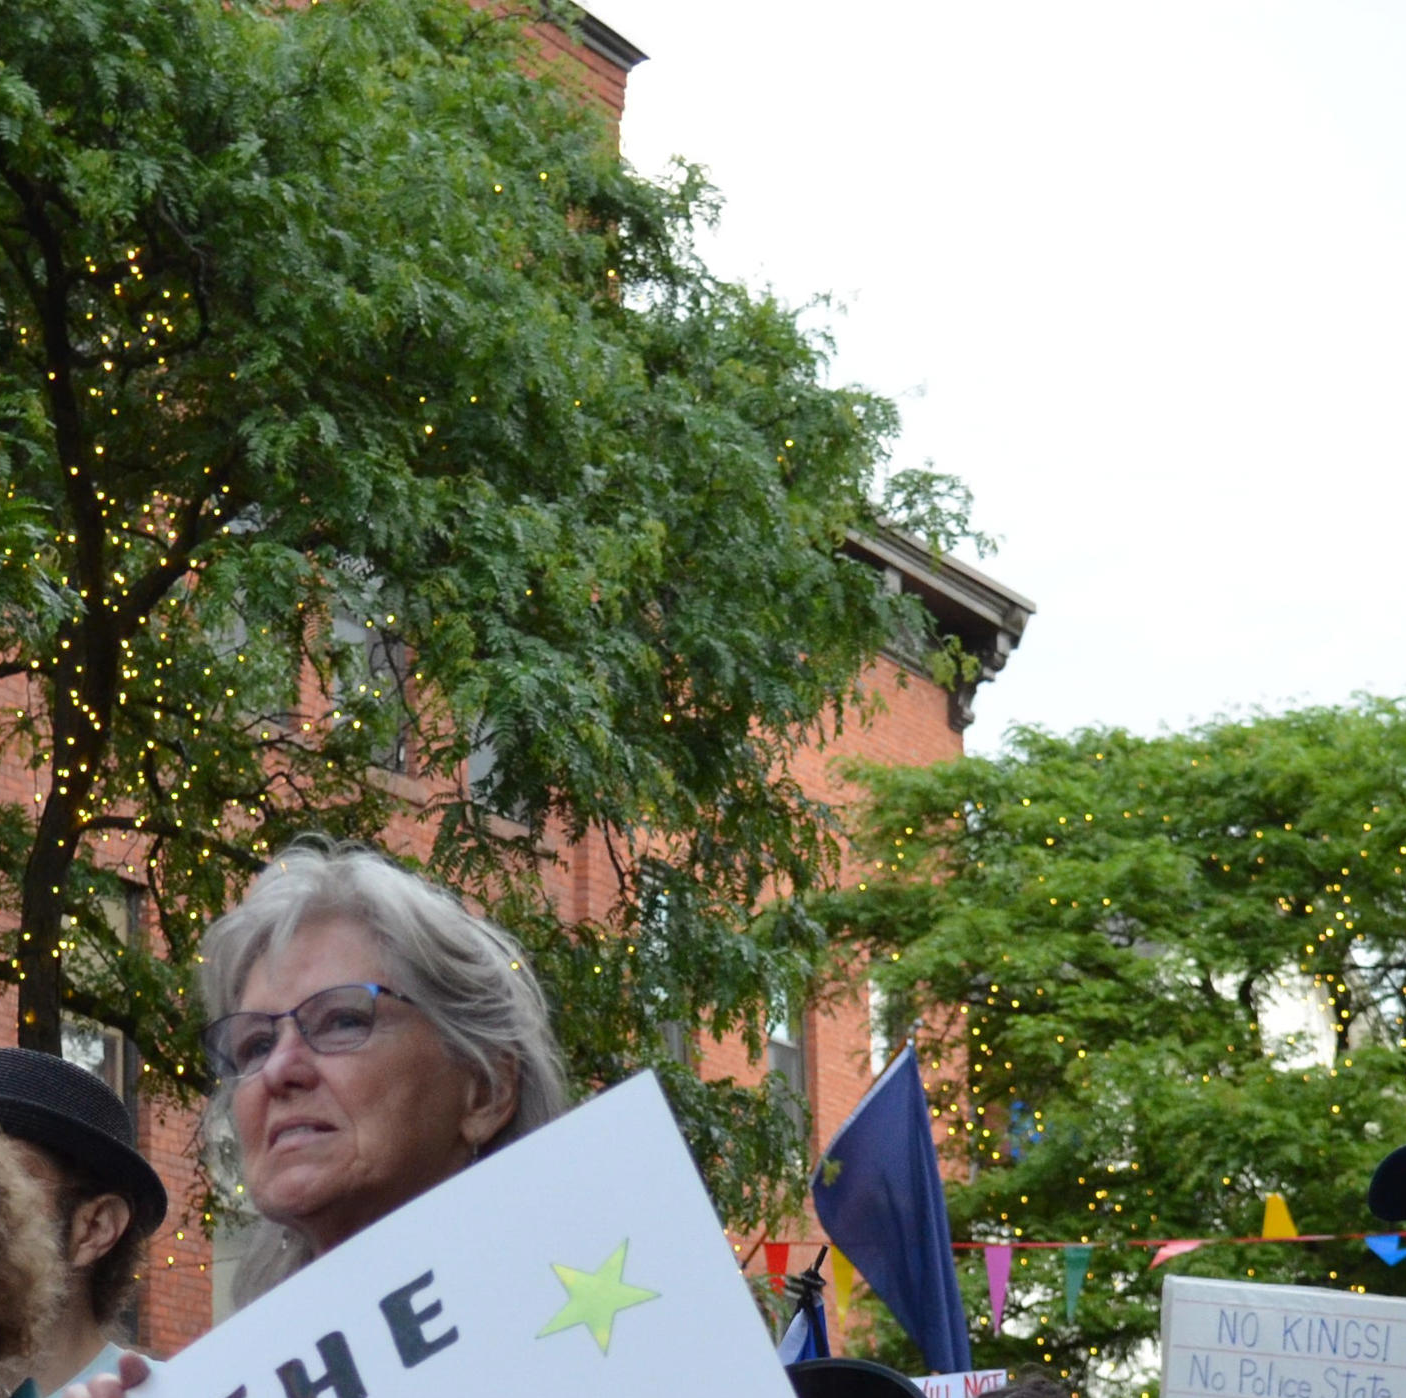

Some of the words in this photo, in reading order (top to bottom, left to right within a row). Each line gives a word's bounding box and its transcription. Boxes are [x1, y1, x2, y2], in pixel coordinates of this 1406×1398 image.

[1217, 1308, 1260, 1348] NO
[1282, 1315, 1391, 1363] KINGS!
[1188, 1353, 1226, 1392] No
